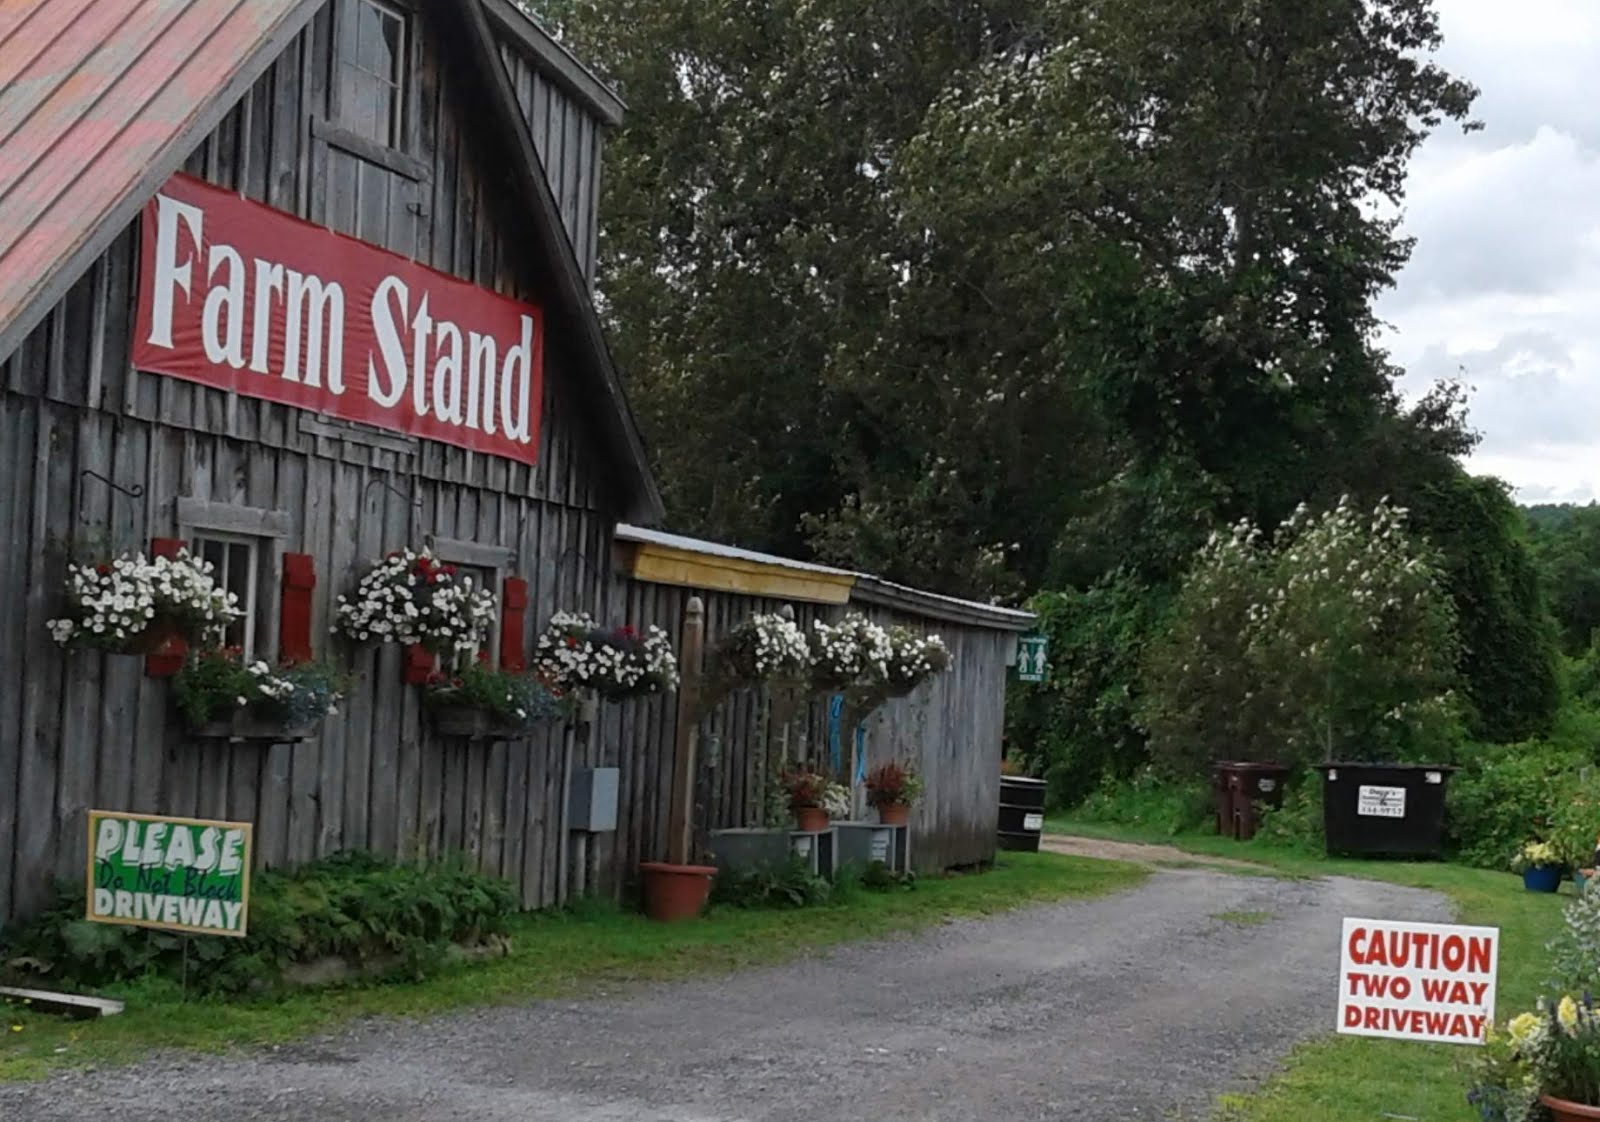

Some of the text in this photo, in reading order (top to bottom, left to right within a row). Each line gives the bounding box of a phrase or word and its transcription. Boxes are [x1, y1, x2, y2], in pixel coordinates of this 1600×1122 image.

[147, 192, 533, 444] Farm Stand
[96, 818, 245, 877] PLEASE
[100, 859, 124, 890] Do
[137, 864, 173, 895] Not
[94, 888, 243, 930] DRIVEWAY
[1348, 927, 1492, 974] CAUTION
[1347, 972, 1489, 1005] TWO WAY
[1344, 1004, 1487, 1038] DRIVEWAY
